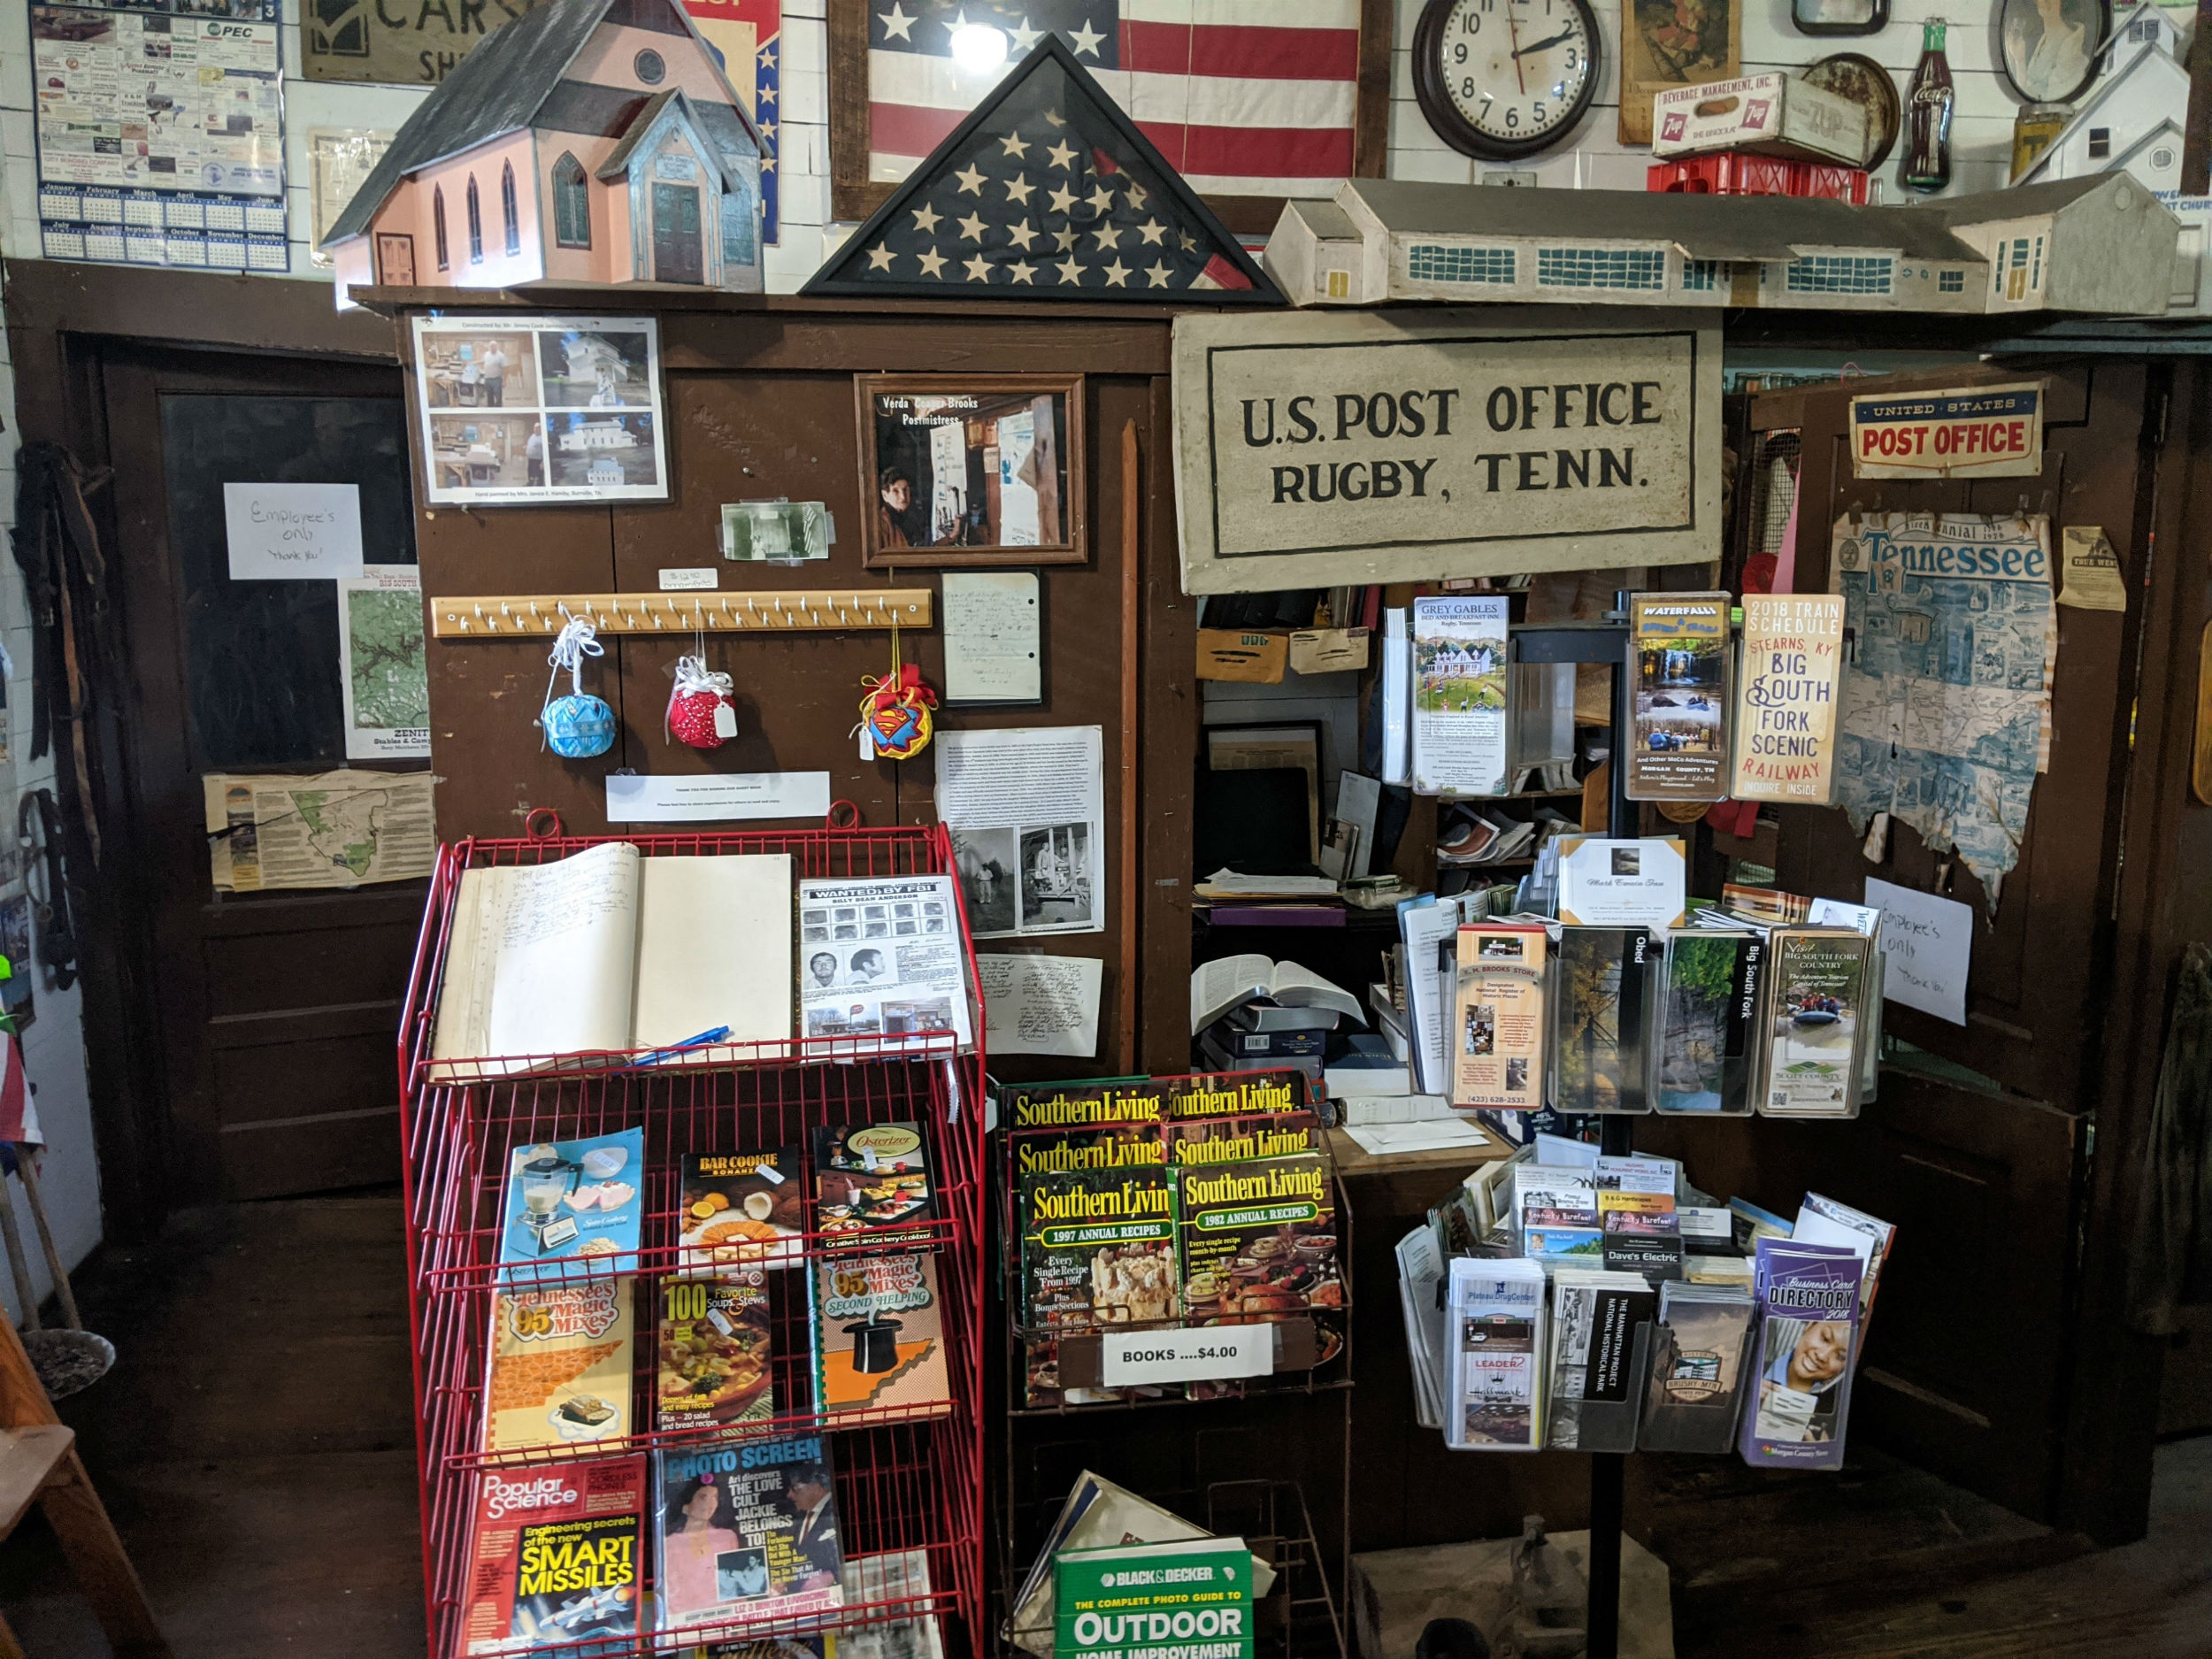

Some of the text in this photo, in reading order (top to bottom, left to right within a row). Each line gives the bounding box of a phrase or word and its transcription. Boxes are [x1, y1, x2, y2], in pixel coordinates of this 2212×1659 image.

[222, 26, 253, 38] PEC
[1462, 13, 1480, 35] 10
[1563, 19, 1573, 35] 2
[1455, 43, 1468, 65] 9
[1565, 48, 1577, 69] 3
[1462, 77, 1475, 98] 8
[1663, 76, 1772, 105] BEVERAGE MANAGEMENT, INC.
[1479, 98, 1493, 119] 7
[1532, 102, 1547, 122] 5
[1506, 108, 1518, 128] 6
[44, 183, 77, 192] January
[86, 186, 120, 195] February
[132, 188, 157, 197] March
[883, 396, 979, 409] Verda Brooks
[1486, 381, 1663, 433] OFFICE
[1873, 397, 2016, 417] UNITED STATES
[902, 413, 959, 426] Postmistress
[1863, 421, 2025, 457] POST OFFICE
[1271, 447, 1648, 503] RUGBY, TENN.
[2073, 557, 2094, 566] TRUE
[1421, 604, 1498, 614] GREY GABLES
[1644, 606, 1717, 616] WATERFALLS
[1751, 602, 1839, 618] 2018 TRAIN
[1749, 618, 1839, 634] SCHEDULE
[1749, 637, 1833, 657] STEARNS, KY
[1771, 653, 1807, 675] BIG
[1762, 710, 1810, 732] FORK
[1751, 734, 1819, 757] SCENIC
[1742, 758, 1821, 780] RAILWAY
[1786, 782, 1817, 796] INSIDE
[816, 888, 877, 899] WANTED
[1634, 936, 1647, 964] Obed
[1786, 941, 1816, 953] Visit
[1513, 967, 1535, 977] STORE
[1740, 945, 1761, 1019] Big South Fork
[1017, 1083, 1293, 1126] Southern Living Living
[1490, 1095, 1525, 1104] 628-2533
[855, 1133, 911, 1148] Osterizer
[699, 1152, 779, 1171] BAR COOKIE
[1019, 1132, 1256, 1173] Southern Southern
[1033, 1166, 1325, 1220] Southern Southern Living
[1053, 1206, 1310, 1242] 1997 ANNUAL RECIPES 1982 ANNUAL RECIPES
[1528, 1210, 1671, 1225] Kentucky Barefoot Kentucky Barefoot
[1189, 1245, 1237, 1256] month-by-month
[1206, 1237, 1242, 1248] single recipe
[1048, 1256, 1073, 1266] Every
[1609, 1250, 1678, 1263] Dave's Electric
[1033, 1265, 1089, 1278] Single Recipe
[835, 1271, 865, 1295] 95
[1040, 1275, 1082, 1287] From 1997
[1789, 1277, 1855, 1290] Business Card
[664, 1283, 757, 1322] 100 Favorite
[707, 1294, 765, 1309] Soups Stews
[828, 1291, 927, 1313] SECOND HELPING
[1054, 1293, 1071, 1303] Plus
[1468, 1291, 1535, 1302] Plateau DrugCenter
[1770, 1287, 1855, 1309] DIRECTORY
[1034, 1300, 1090, 1313] Bonus Sections
[1825, 1310, 1850, 1320] 2018
[516, 1307, 551, 1336] 95
[1595, 1297, 1617, 1392] NATIONAL PARK
[1609, 1298, 1628, 1387] THE MANHATTAN PROJECT
[1123, 1348, 1177, 1363] BOOKS
[1475, 1359, 1516, 1369] LEADER
[690, 1402, 715, 1410] recipes
[693, 1411, 710, 1420] salad
[675, 1421, 695, 1430] bread
[668, 1449, 737, 1482] PHOTO
[741, 1437, 821, 1469] SCREEN
[728, 1471, 781, 1485] Ari discovers
[729, 1477, 784, 1496] THE LOVE
[482, 1474, 565, 1501] Popular
[487, 1488, 579, 1519] Science
[732, 1493, 761, 1509] CULT
[735, 1503, 778, 1521] JACKIE
[525, 1516, 636, 1538] Engineering secrets
[740, 1514, 794, 1534] BELONGS
[557, 1532, 583, 1543] new
[745, 1532, 766, 1547] TO!
[520, 1535, 635, 1574] SMART
[518, 1562, 634, 1597] MISSILES
[1075, 1591, 1242, 1609] THE COMPLETE PHOTO GUIDE TO
[1073, 1608, 1243, 1646] OUTDOOR
